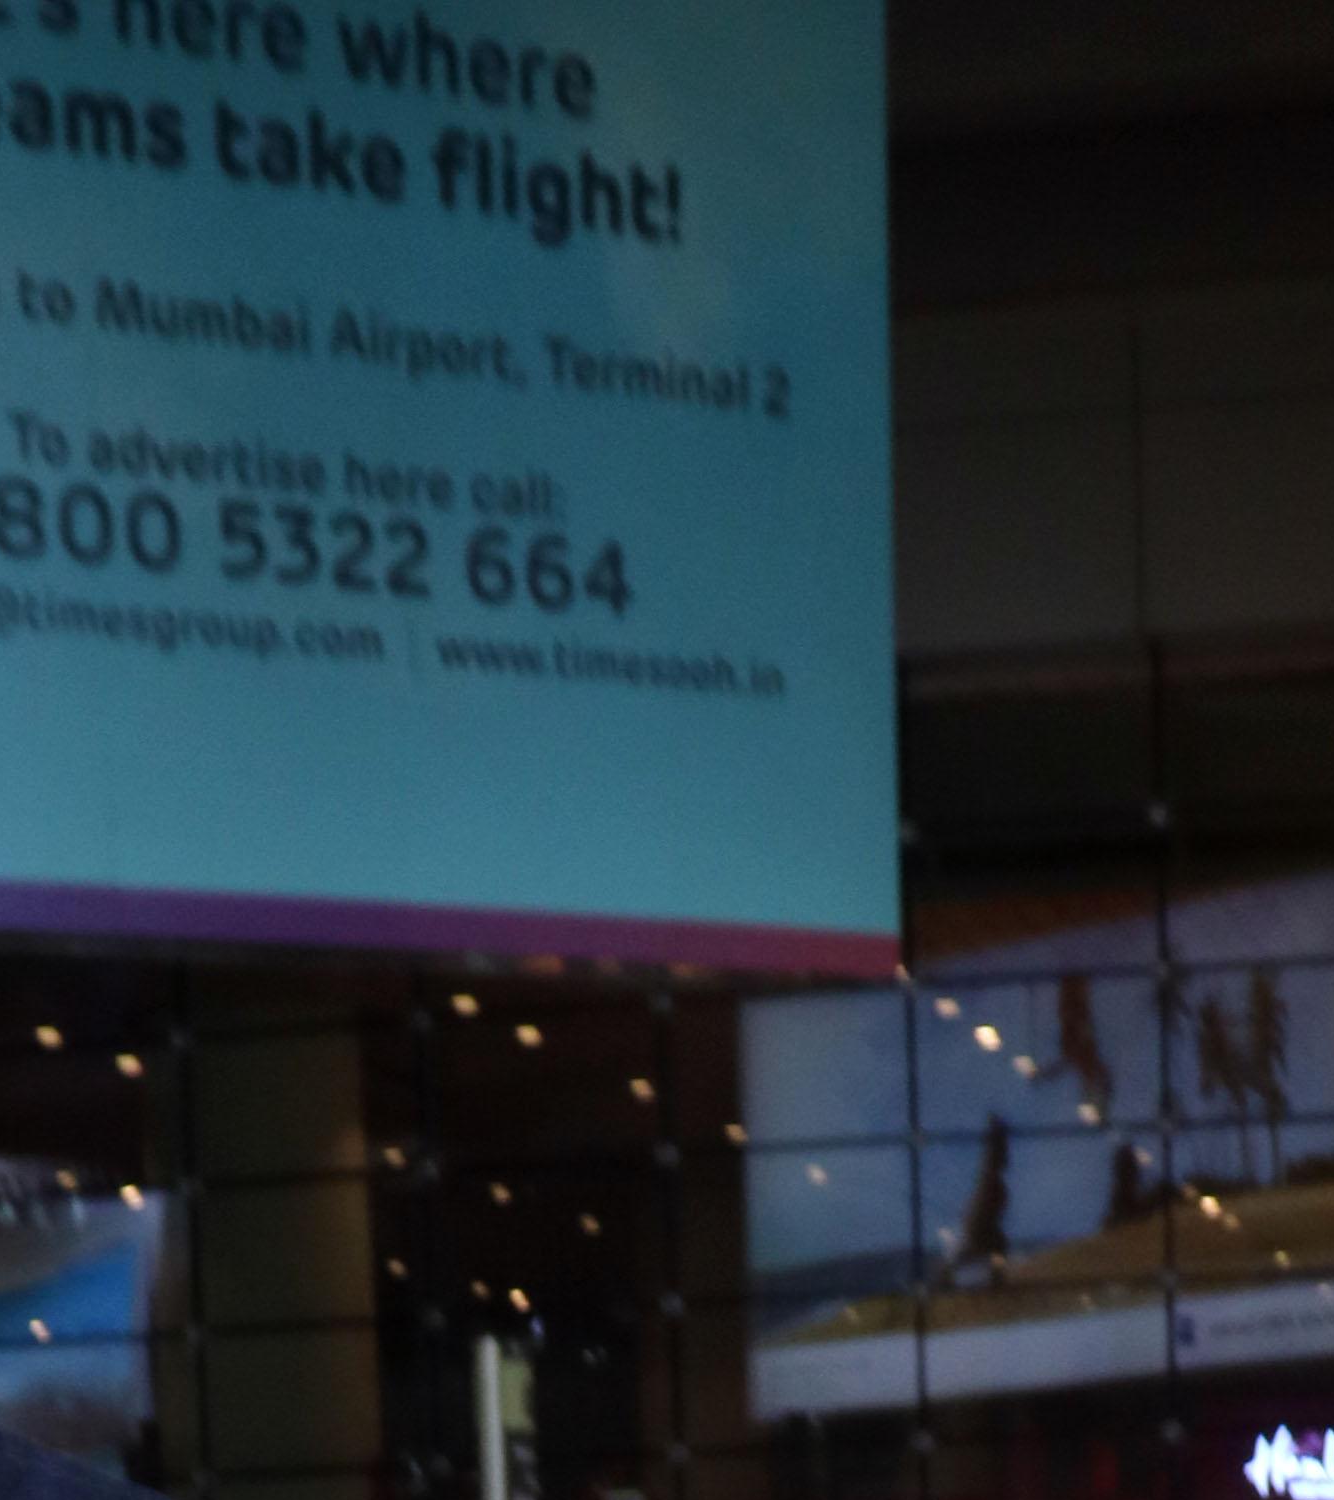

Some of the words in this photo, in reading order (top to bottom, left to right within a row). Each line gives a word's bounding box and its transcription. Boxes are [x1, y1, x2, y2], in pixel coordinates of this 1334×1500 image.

[339, 11, 595, 119] where
[214, 100, 405, 201] take
[430, 128, 683, 248] flight!
[16, 267, 75, 325] to
[95, 274, 310, 356] Mumbai
[330, 304, 529, 392] Airport,
[543, 330, 751, 412] Terminal
[764, 361, 792, 420] 2
[11, 412, 69, 468] To
[88, 425, 328, 498] advertise
[342, 452, 455, 513] here
[218, 498, 431, 600] 5322
[466, 521, 632, 618] 664
